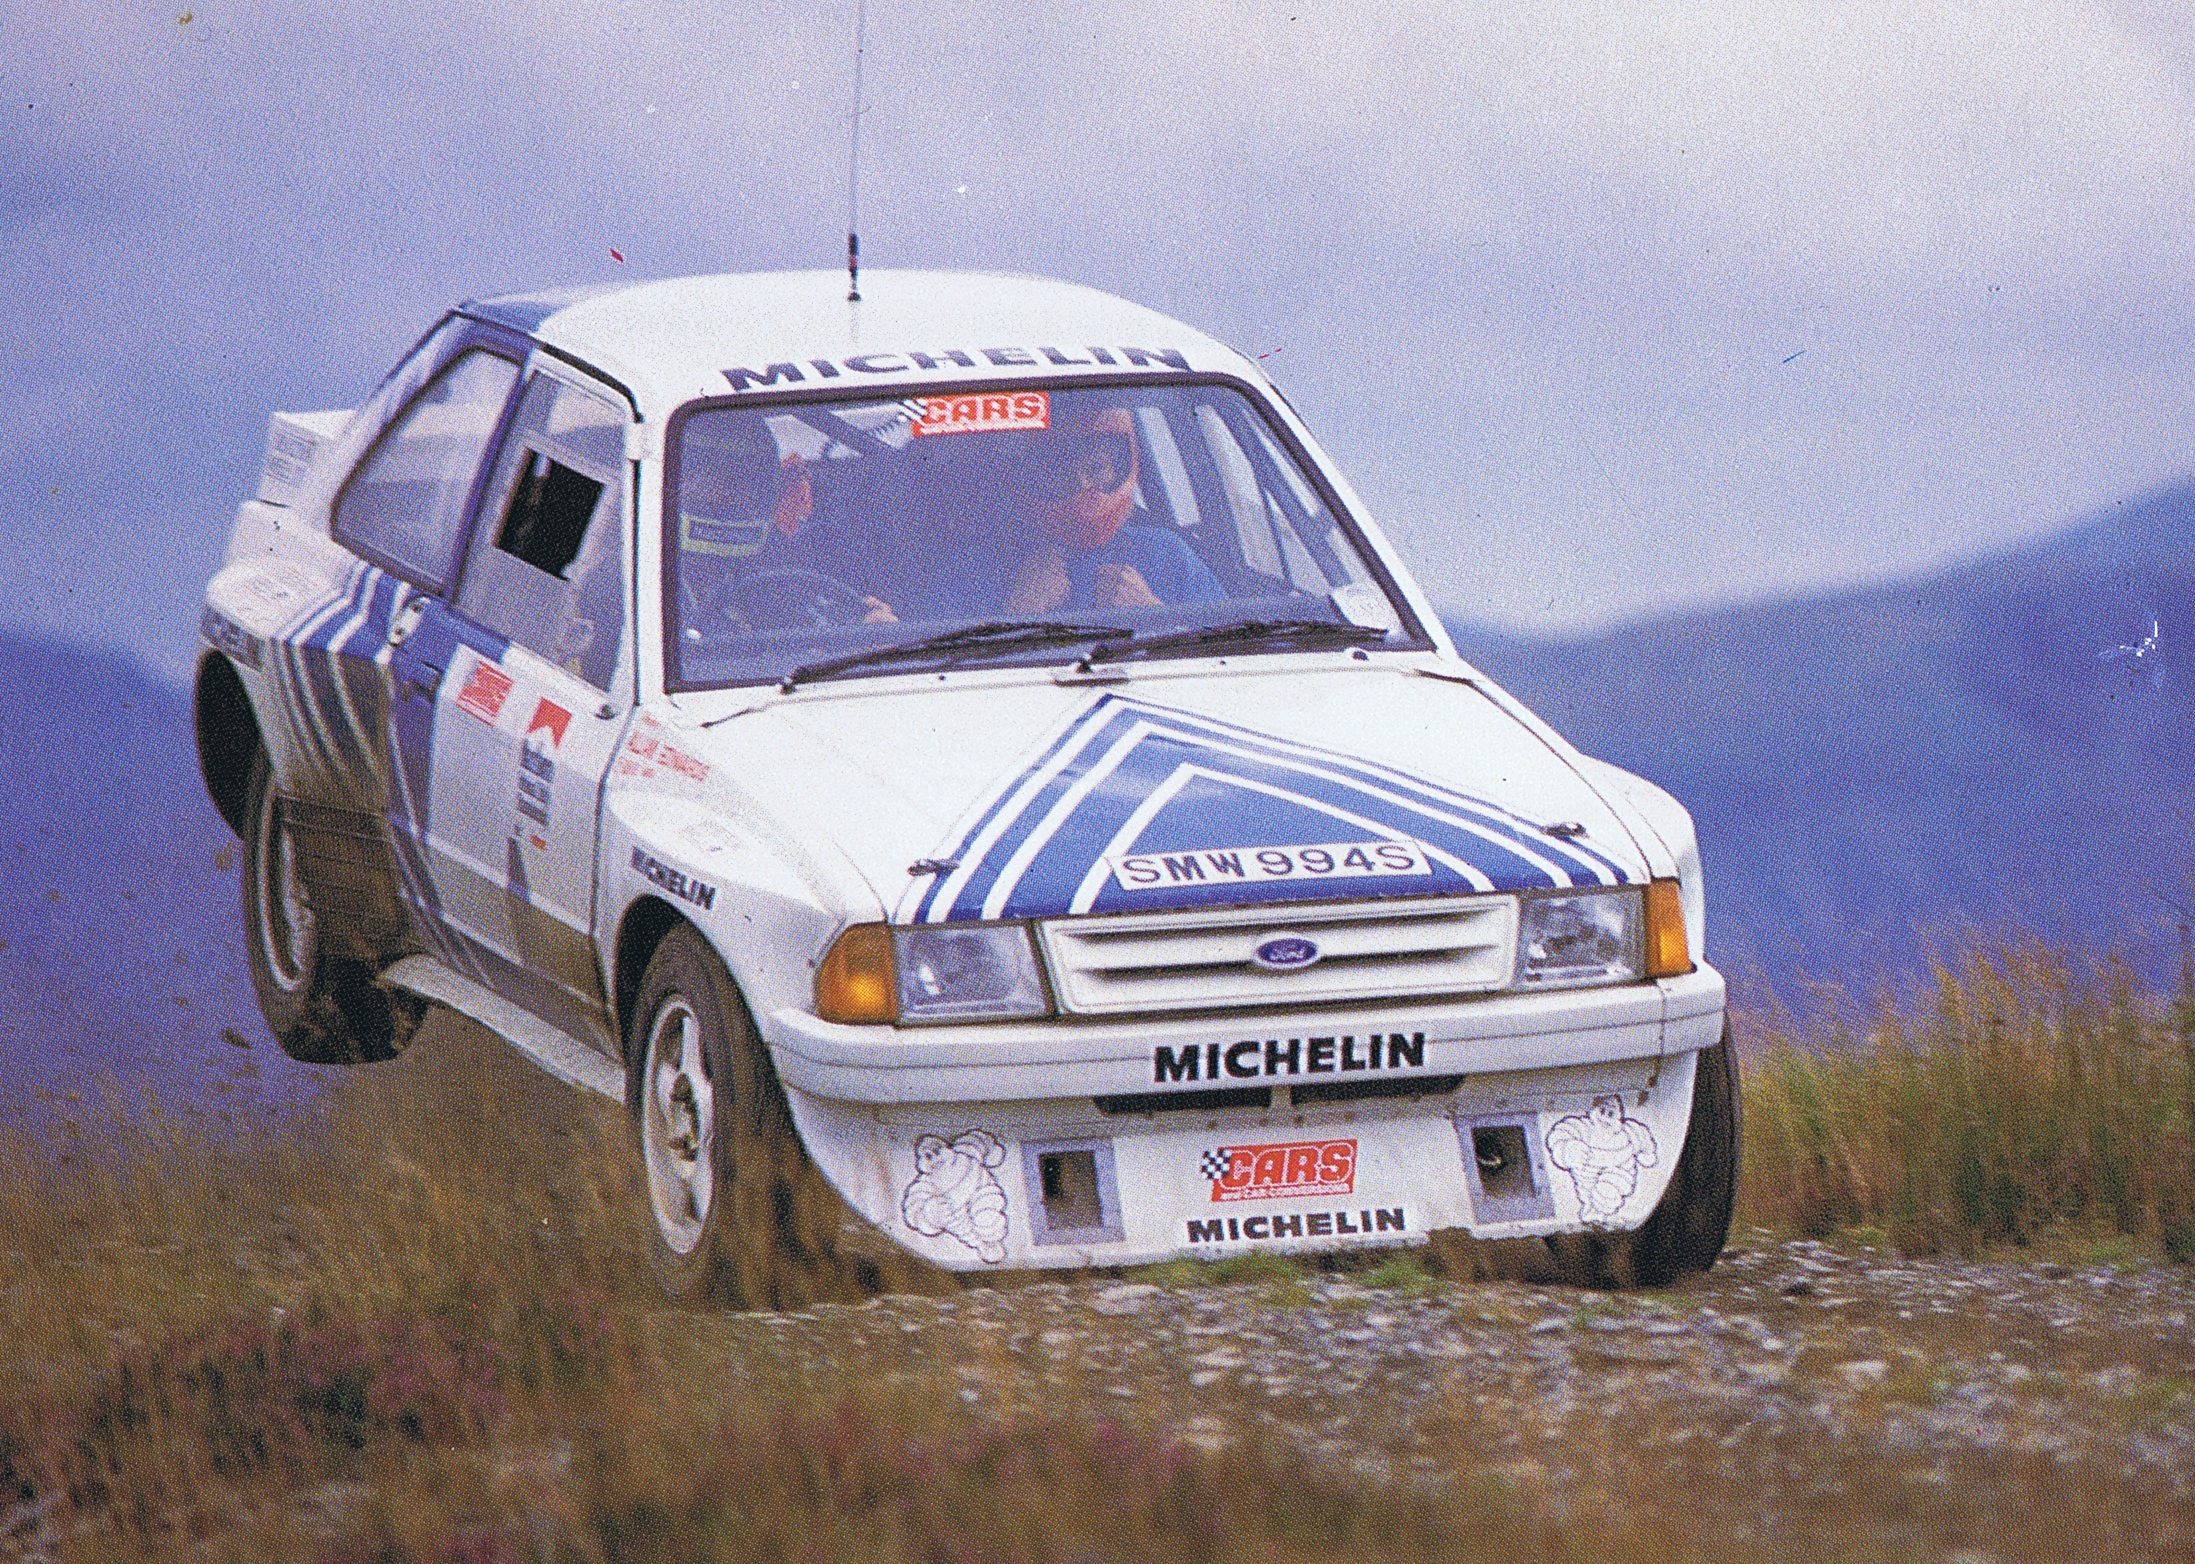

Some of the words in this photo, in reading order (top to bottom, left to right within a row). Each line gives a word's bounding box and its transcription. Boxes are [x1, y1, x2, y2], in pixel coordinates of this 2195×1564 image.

[721, 346, 1194, 392] MICHELIN
[924, 394, 1044, 425] CARS
[1122, 854, 1246, 884] SMW
[1257, 844, 1416, 876] 994S
[1153, 1032, 1426, 1083] MICHELIN
[1220, 1143, 1354, 1189] CARS
[1186, 1207, 1406, 1243] MICHELIN
